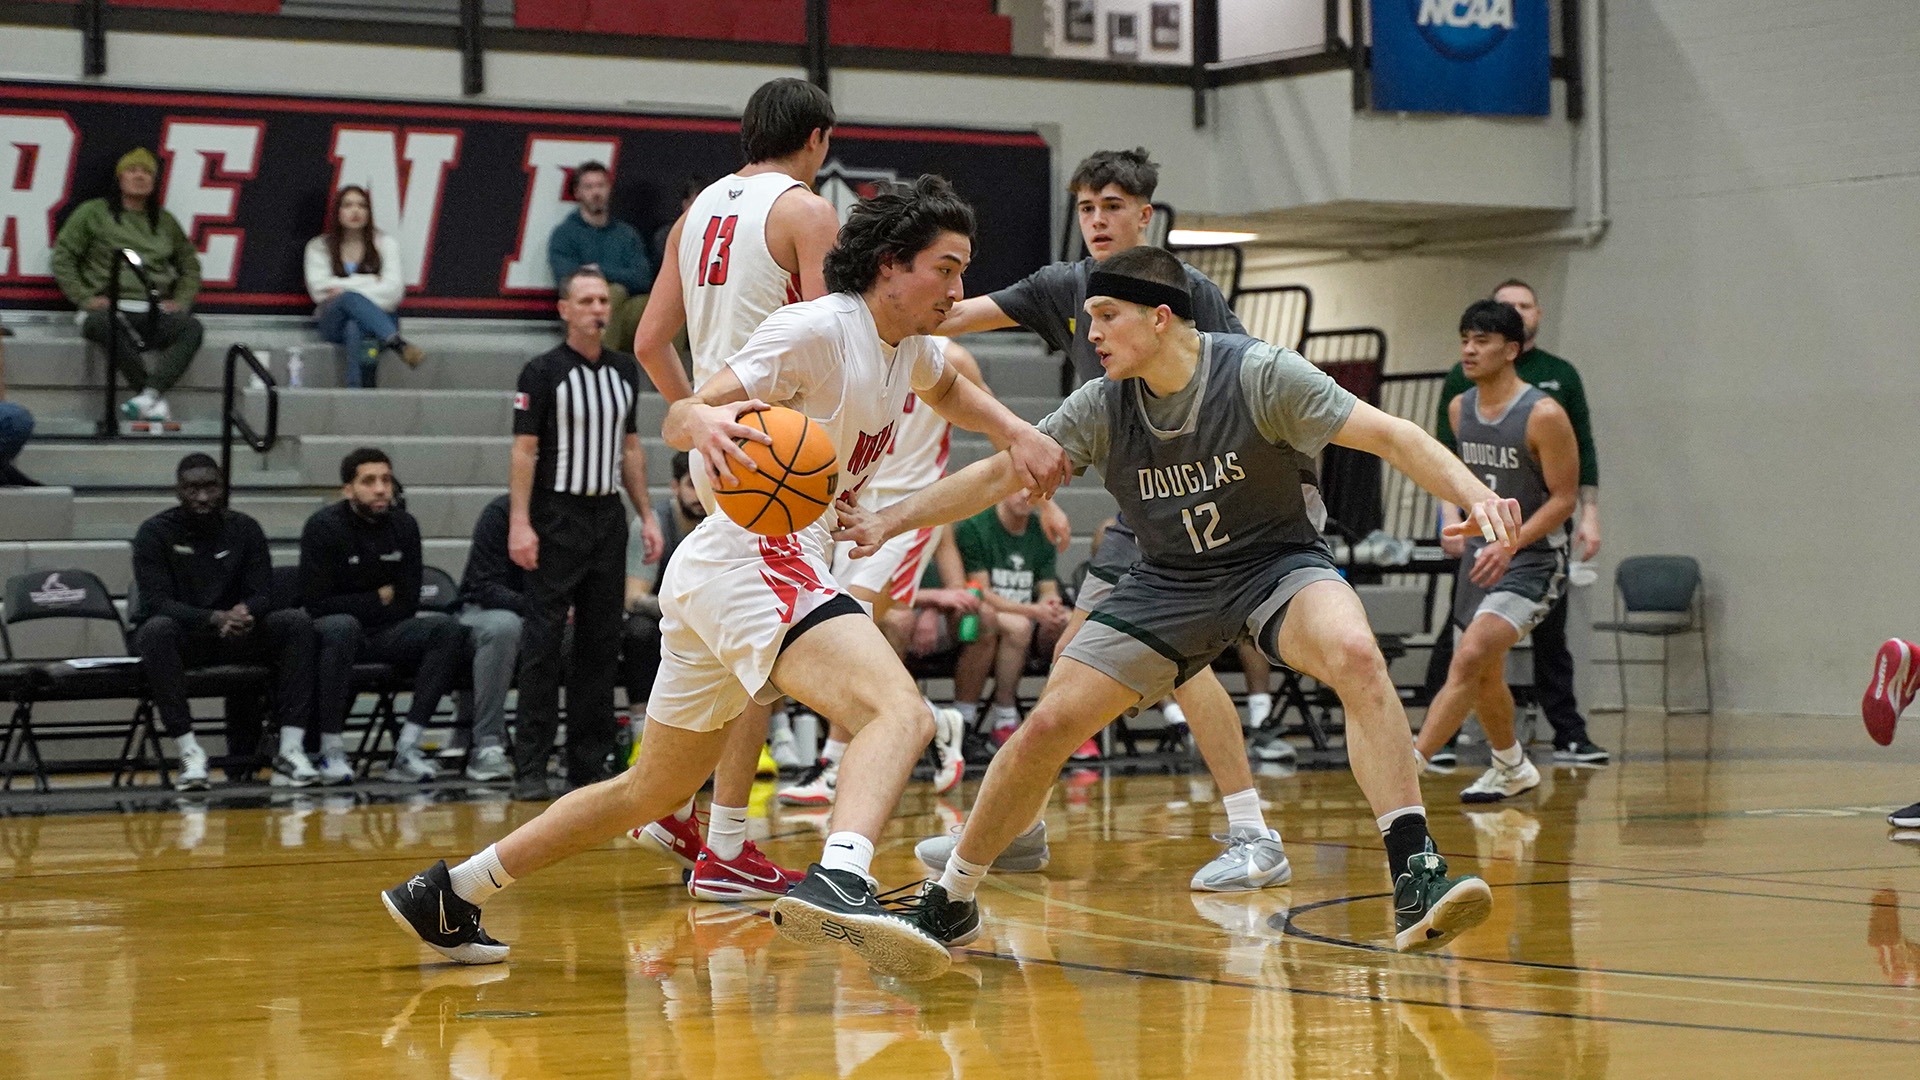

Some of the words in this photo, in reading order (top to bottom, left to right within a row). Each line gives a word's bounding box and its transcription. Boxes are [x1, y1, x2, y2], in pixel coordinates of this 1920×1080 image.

[1416, 0, 1516, 29] NCAA
[698, 214, 738, 287] 13
[846, 419, 895, 476] NNU
[1462, 441, 1519, 469] DOUGLAS
[1137, 450, 1246, 501] DOUGLAS
[1181, 501, 1231, 554] 12
